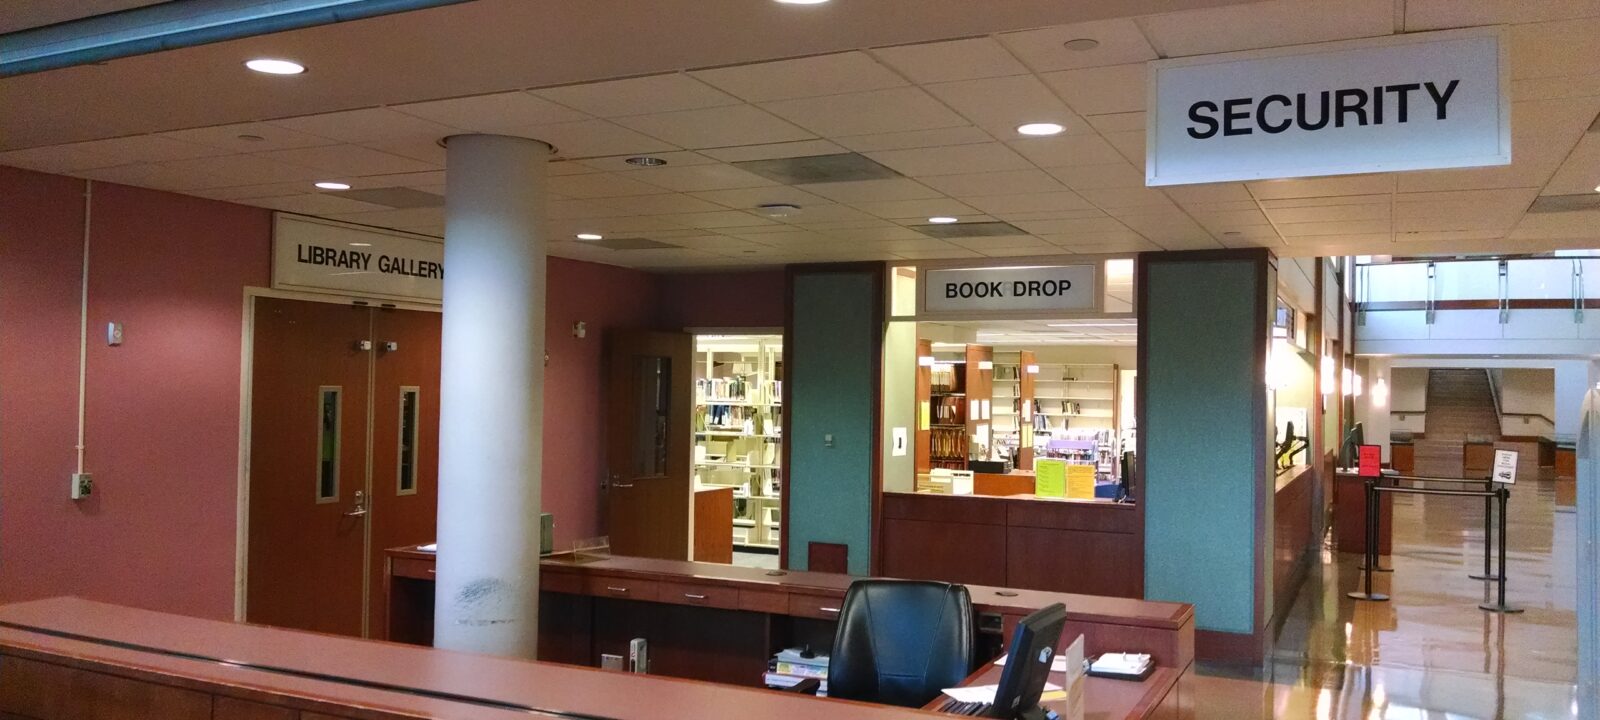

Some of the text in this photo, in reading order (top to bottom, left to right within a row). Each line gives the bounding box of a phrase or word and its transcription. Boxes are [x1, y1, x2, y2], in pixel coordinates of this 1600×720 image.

[1187, 80, 1460, 140] SECURITY
[297, 244, 444, 280] LIBRARY GALLERY
[945, 280, 1072, 298] BOOK DROP
